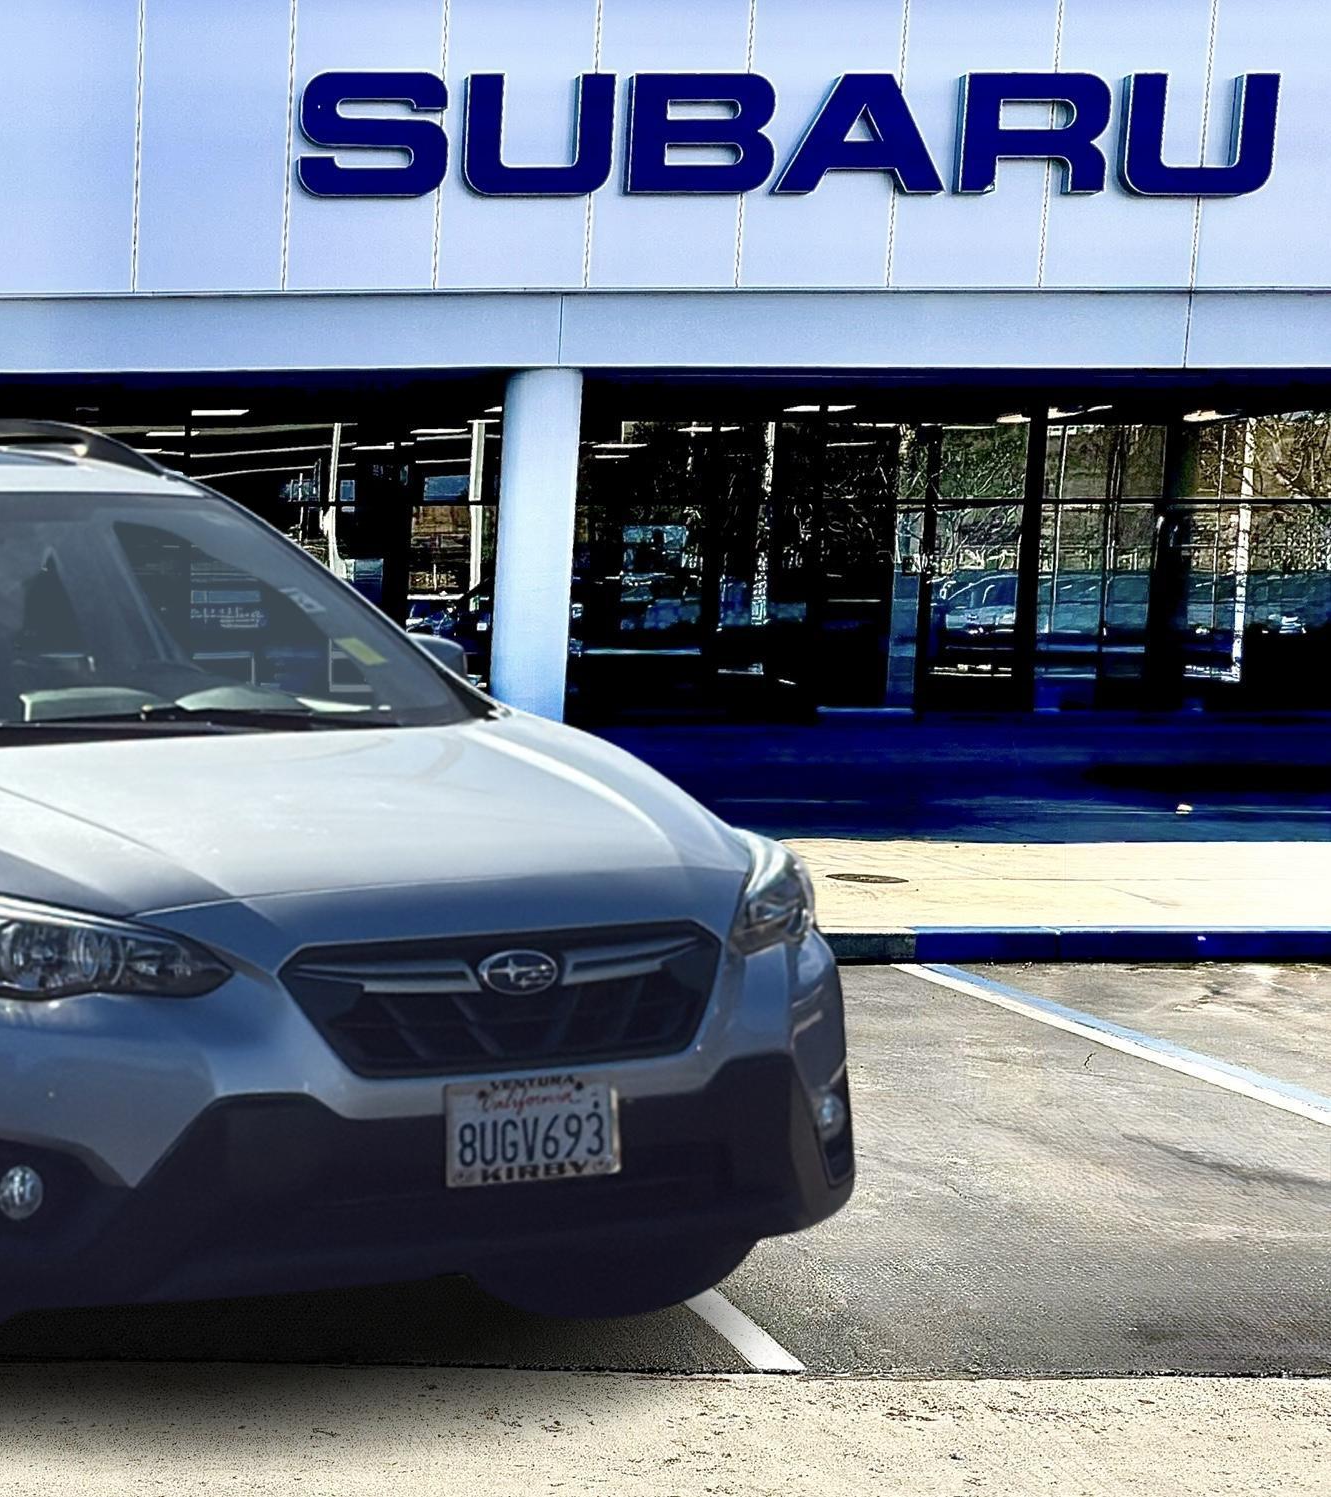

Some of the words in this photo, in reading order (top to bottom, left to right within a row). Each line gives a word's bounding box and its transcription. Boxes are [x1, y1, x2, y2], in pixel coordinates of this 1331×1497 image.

[297, 70, 1281, 197] SUBARU
[489, 1074, 576, 1091] VENTURA
[479, 1089, 581, 1116] California
[458, 1111, 605, 1168] 8UGV693
[481, 1159, 588, 1184] KIRBY
